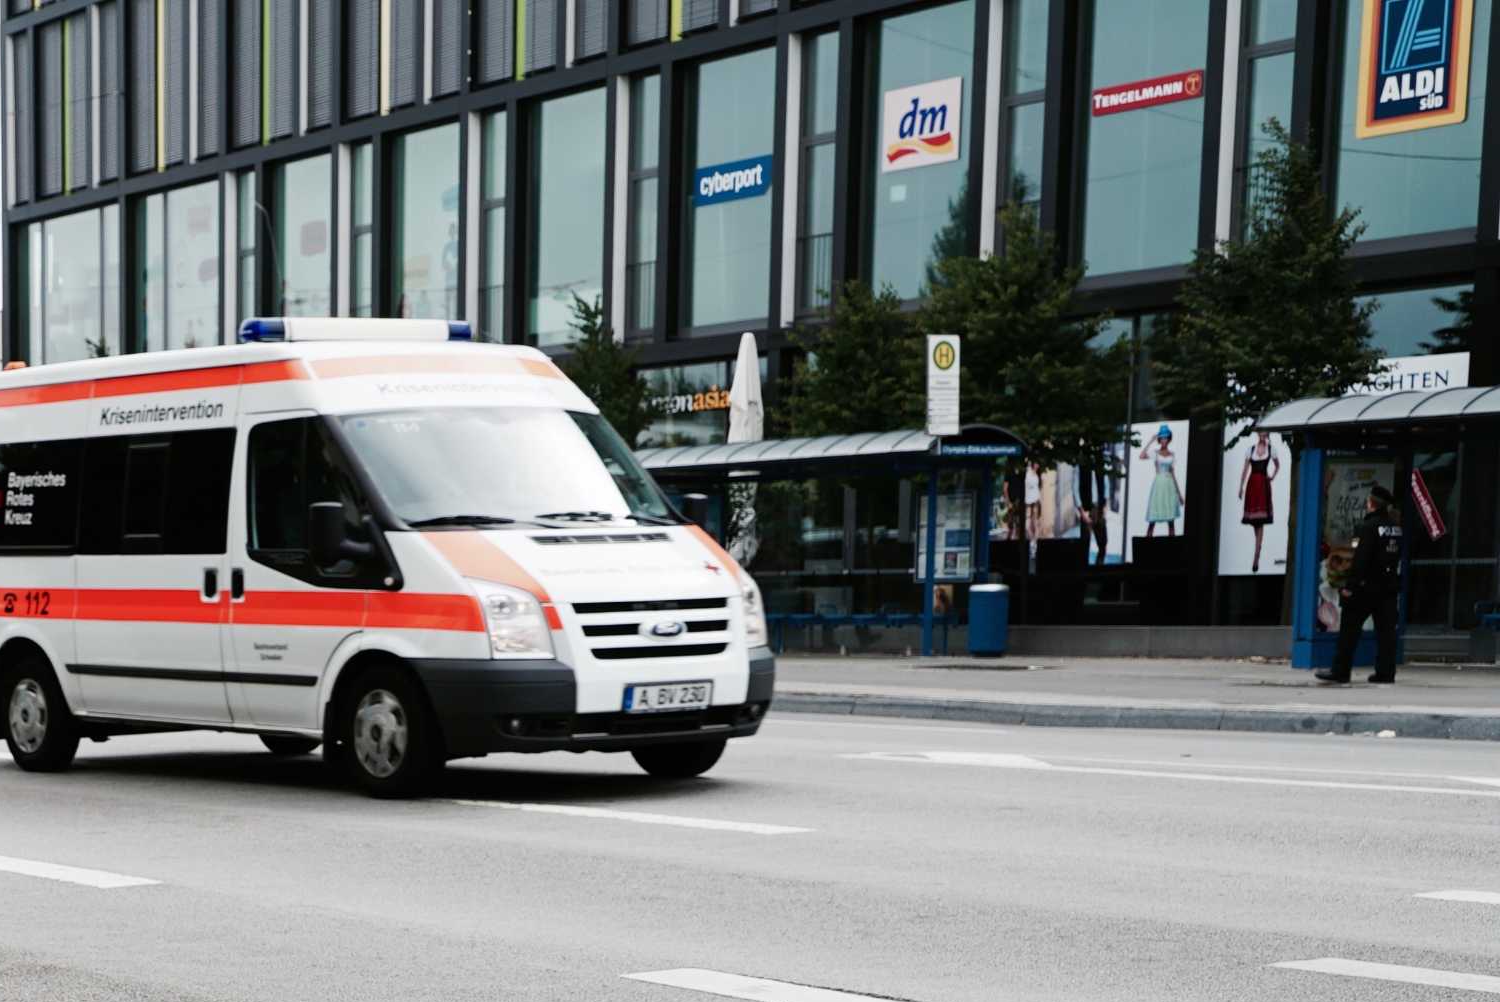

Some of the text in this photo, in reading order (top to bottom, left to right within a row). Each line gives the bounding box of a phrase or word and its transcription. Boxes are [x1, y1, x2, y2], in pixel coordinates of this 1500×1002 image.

[1093, 80, 1183, 109] TENGELMANN
[1380, 67, 1445, 103] ALDI
[1419, 93, 1444, 111] SÜD
[899, 97, 947, 139] dm
[700, 163, 763, 197] cyberport
[100, 401, 223, 426] Krisenintervention
[7, 472, 66, 490] Bayerisches
[5, 491, 35, 506] Rotes
[4, 509, 33, 525] Kreuz
[25, 591, 51, 615] 112
[638, 685, 707, 706] A BV 230
